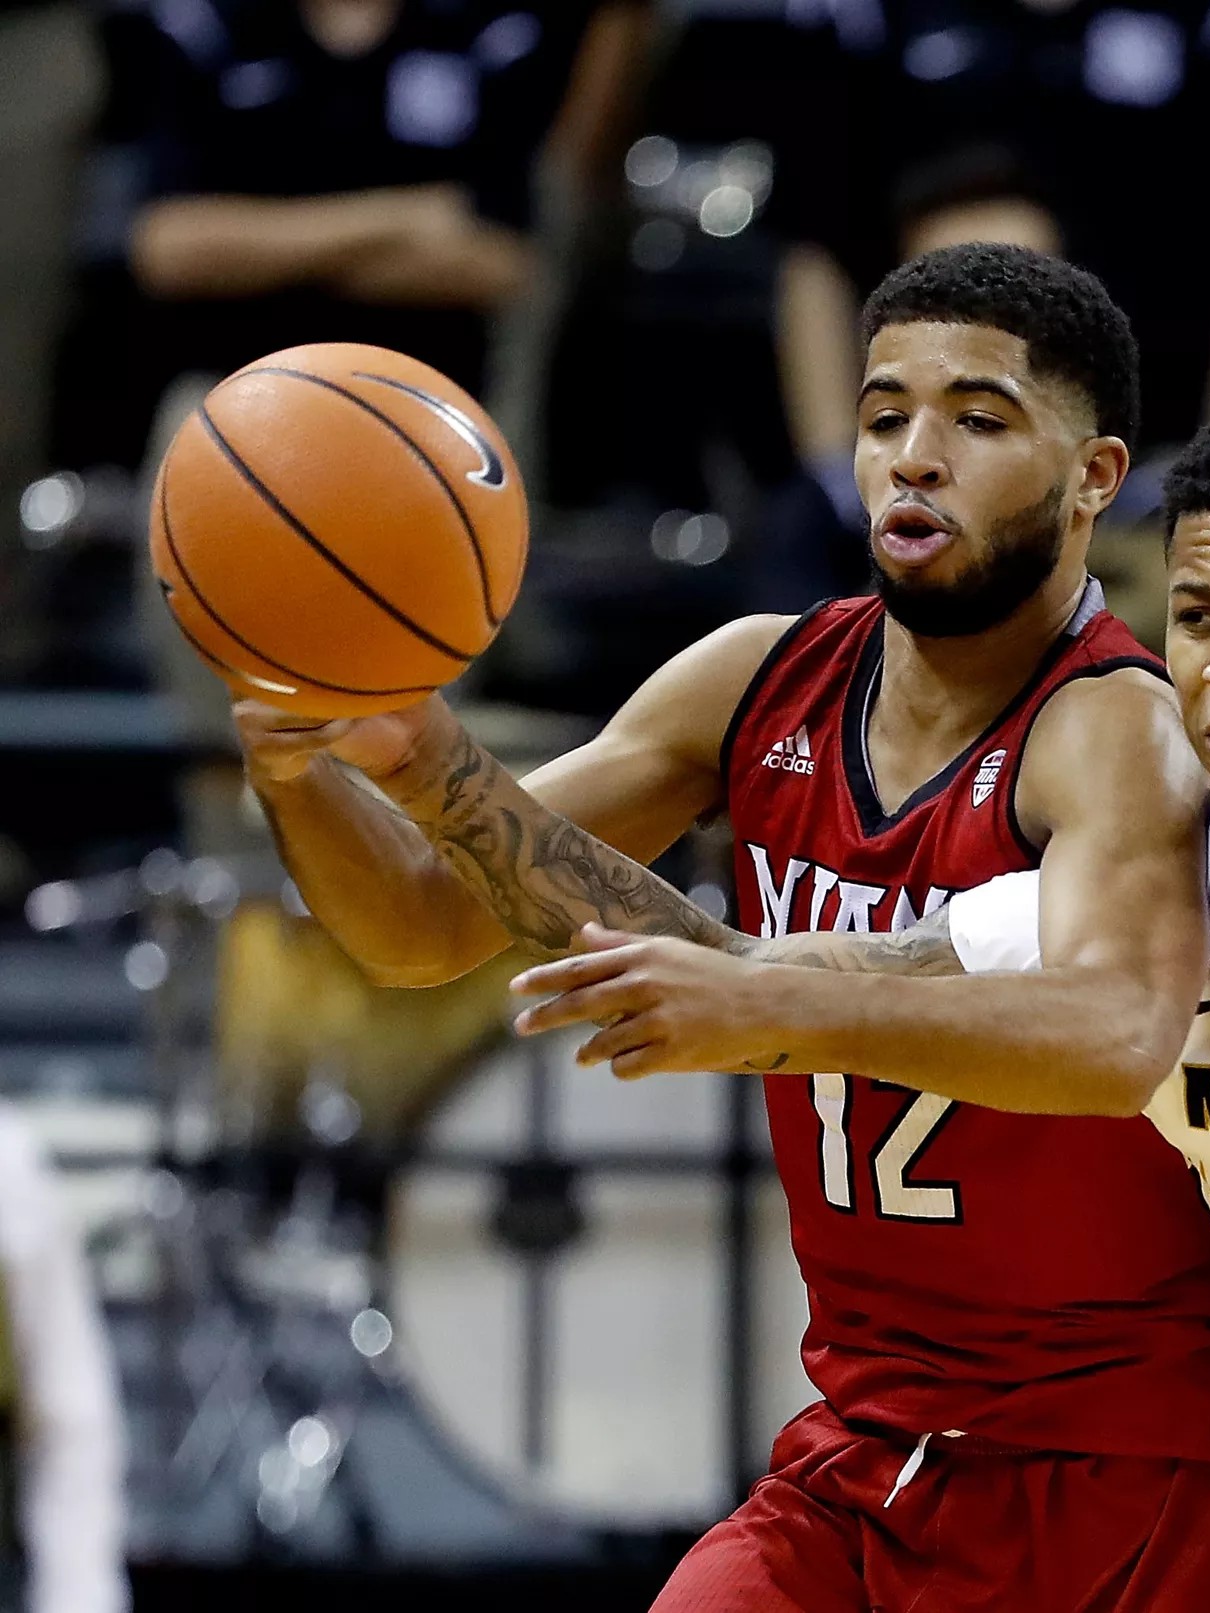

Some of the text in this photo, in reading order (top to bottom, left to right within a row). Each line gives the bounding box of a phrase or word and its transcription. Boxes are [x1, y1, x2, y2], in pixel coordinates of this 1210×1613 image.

[761, 752, 815, 775] ddas
[974, 767, 1000, 784] MA
[747, 843, 966, 938] MIA
[808, 1073, 963, 1226] 12
